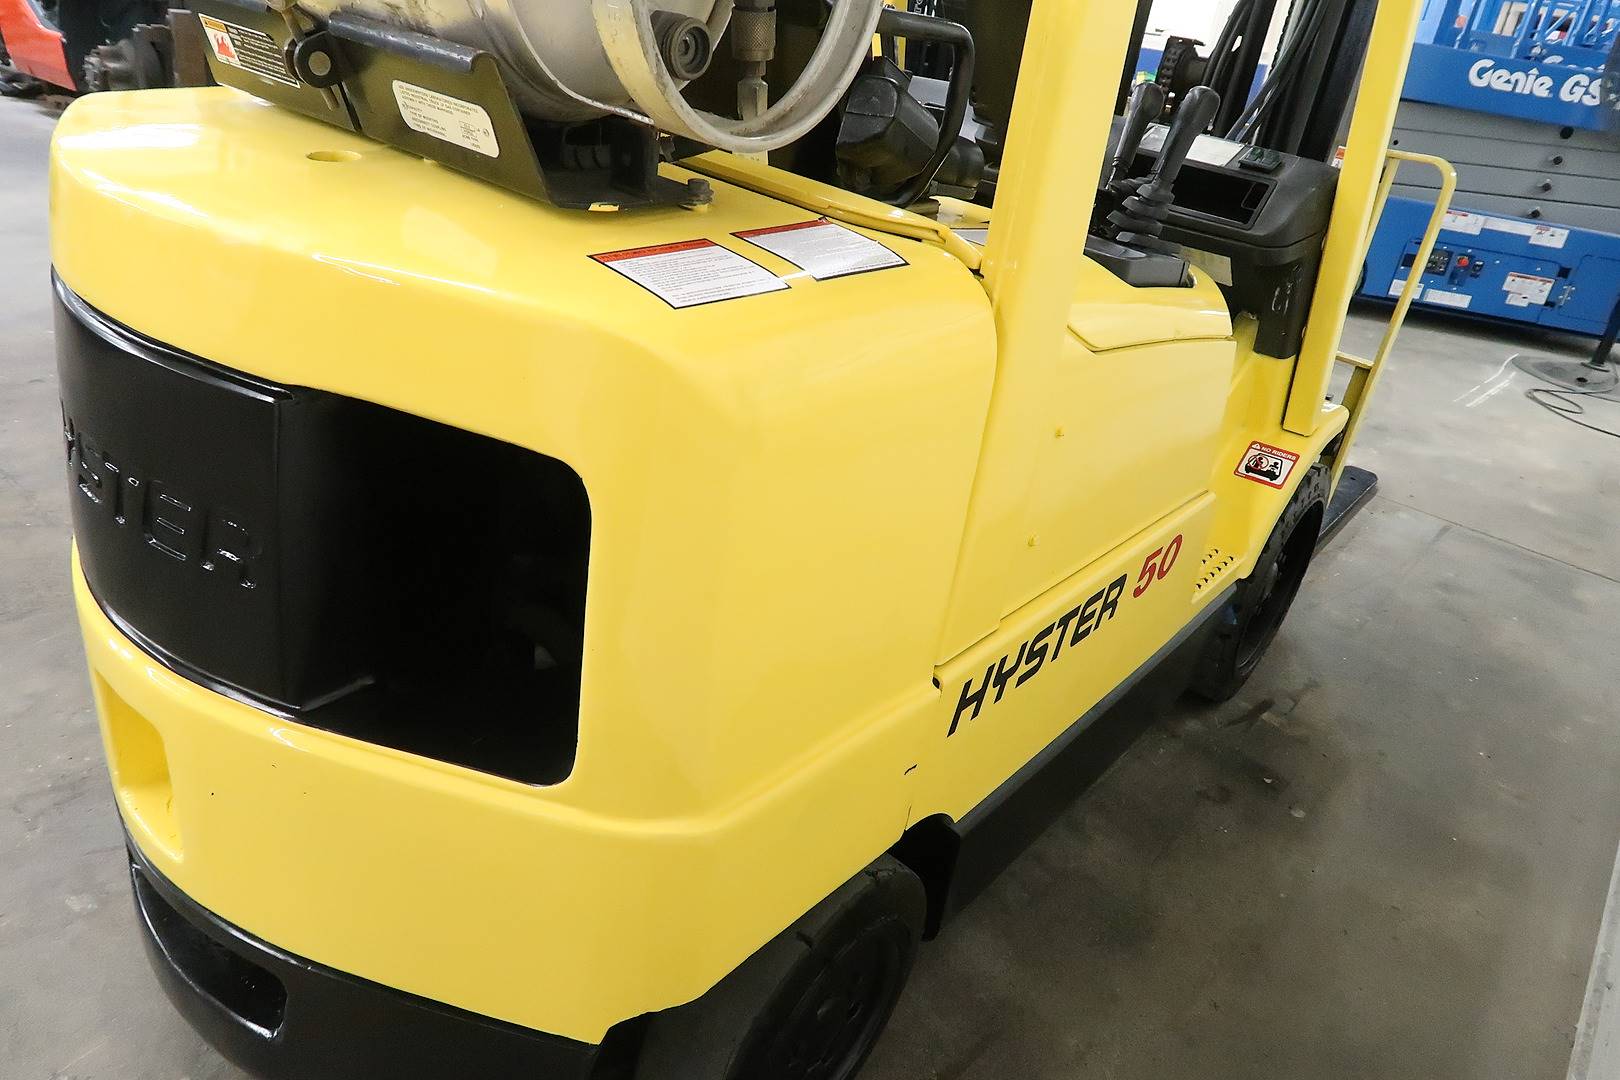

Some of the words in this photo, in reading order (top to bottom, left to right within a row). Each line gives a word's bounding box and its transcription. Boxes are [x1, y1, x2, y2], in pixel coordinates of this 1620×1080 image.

[1468, 59, 1553, 97] Genie
[61, 400, 258, 588] YSTER
[1272, 449, 1296, 460] RIDERS
[947, 573, 1127, 738] HYSTER
[1133, 534, 1183, 598] 50
